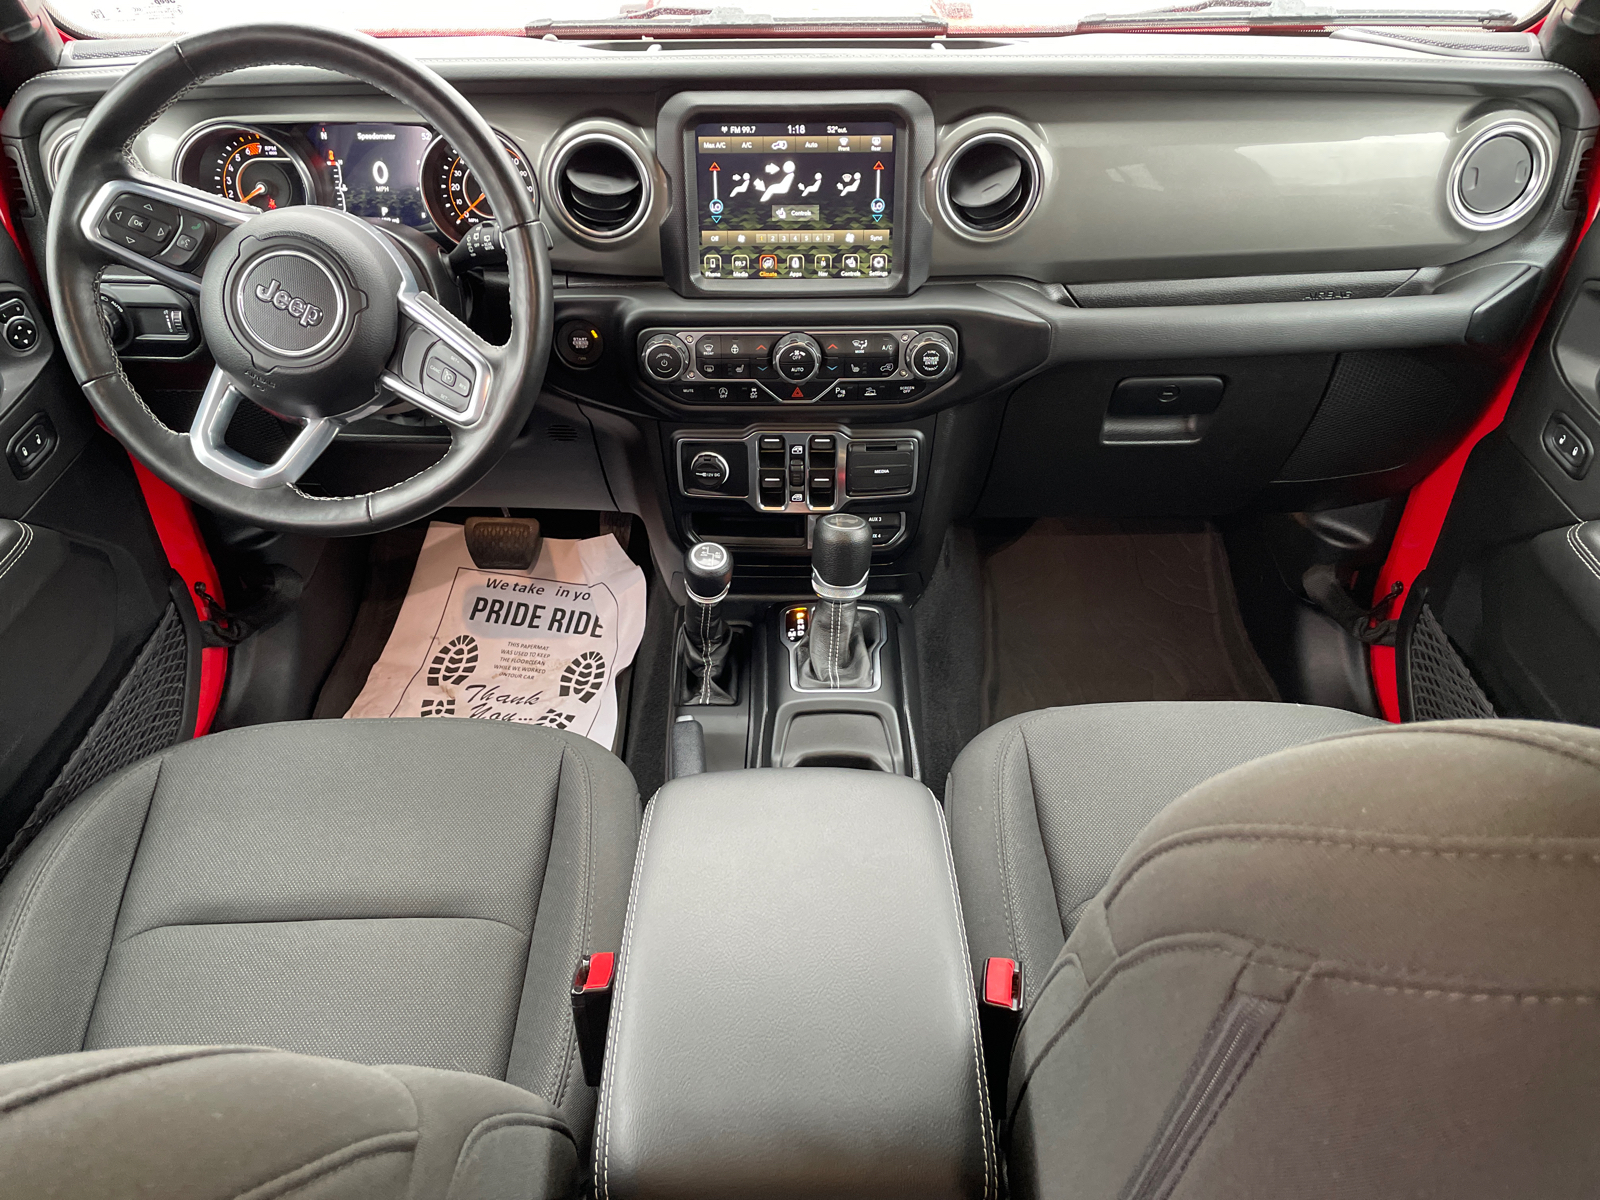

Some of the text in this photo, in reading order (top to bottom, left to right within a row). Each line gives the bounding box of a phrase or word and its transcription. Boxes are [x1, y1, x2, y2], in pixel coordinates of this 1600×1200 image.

[357, 132, 396, 141] Speedometer
[788, 124, 806, 134] 1:18
[235, 154, 241, 162] 5
[372, 160, 388, 184] 0
[255, 279, 323, 327] Jeep
[486, 578, 509, 590] We
[512, 582, 545, 595] take
[555, 586, 570, 598] in
[469, 596, 604, 638] PRIDE RIDE
[465, 684, 543, 705] Thank
